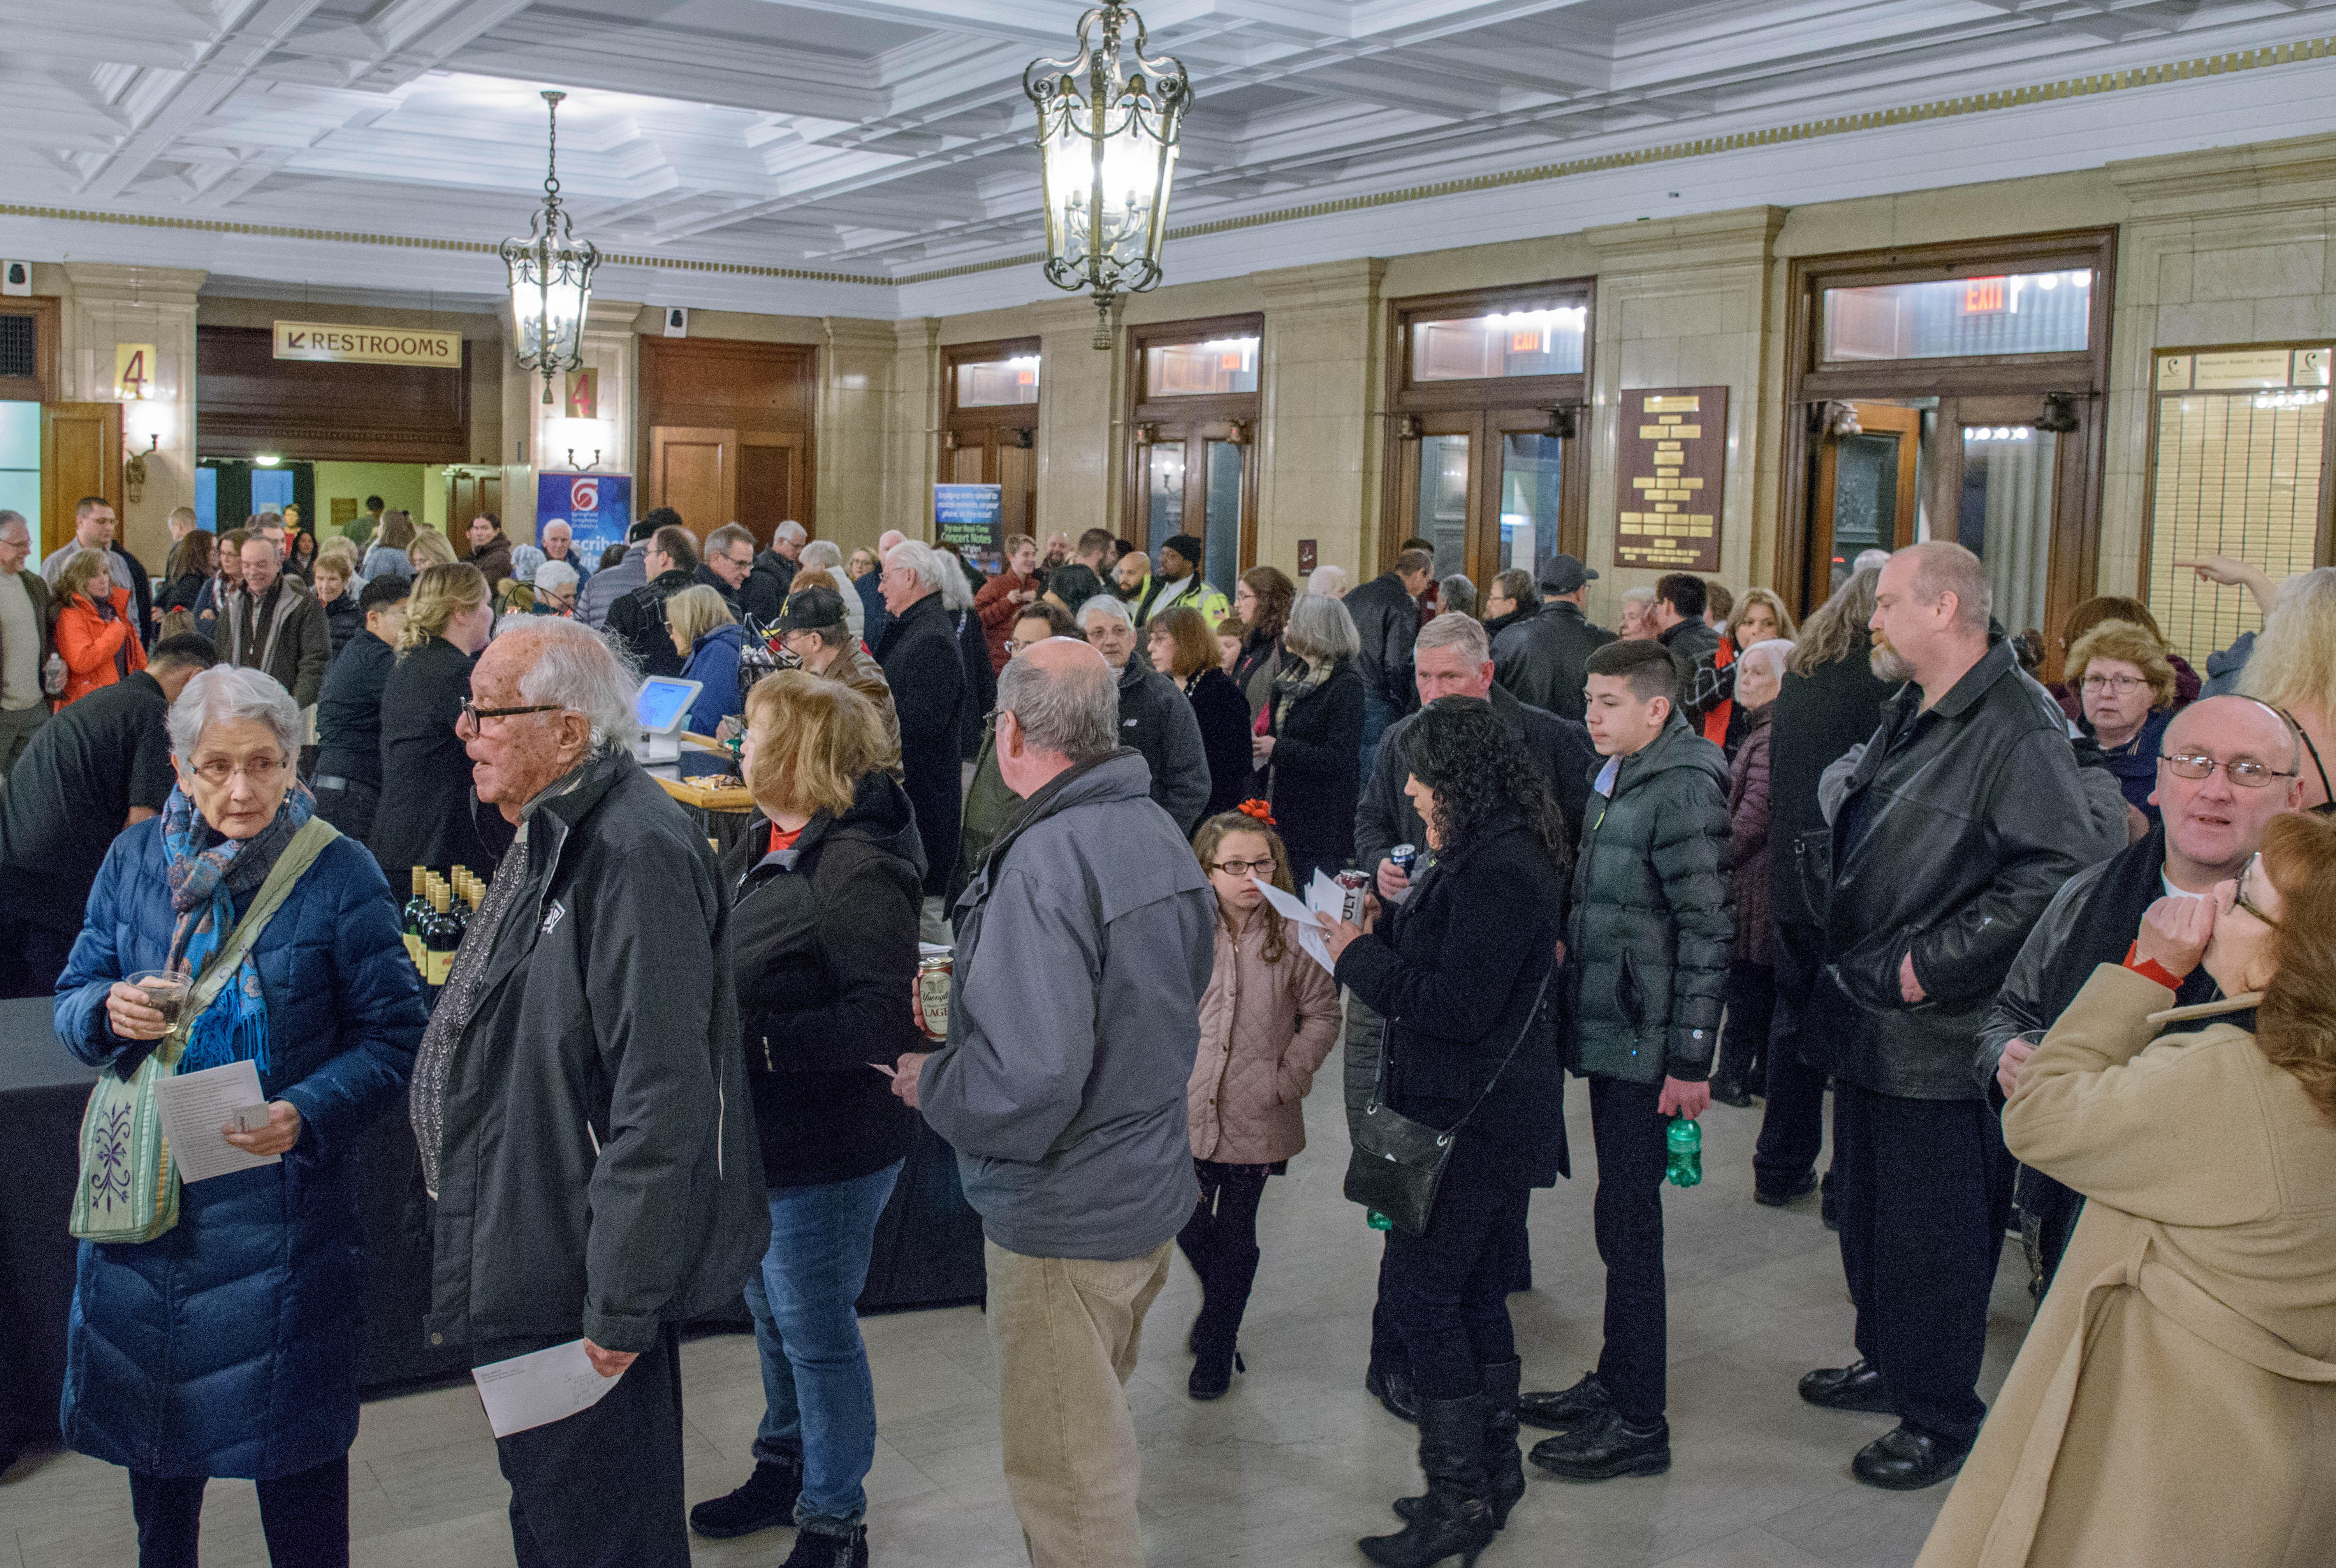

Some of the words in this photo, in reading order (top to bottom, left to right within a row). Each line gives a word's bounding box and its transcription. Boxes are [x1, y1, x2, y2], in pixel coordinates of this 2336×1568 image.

[1965, 277, 2004, 311] EXIT
[312, 333, 449, 357] RESTROOMS
[123, 351, 148, 397] 4
[571, 374, 591, 414] 4
[925, 1008, 948, 1017] LAGE
